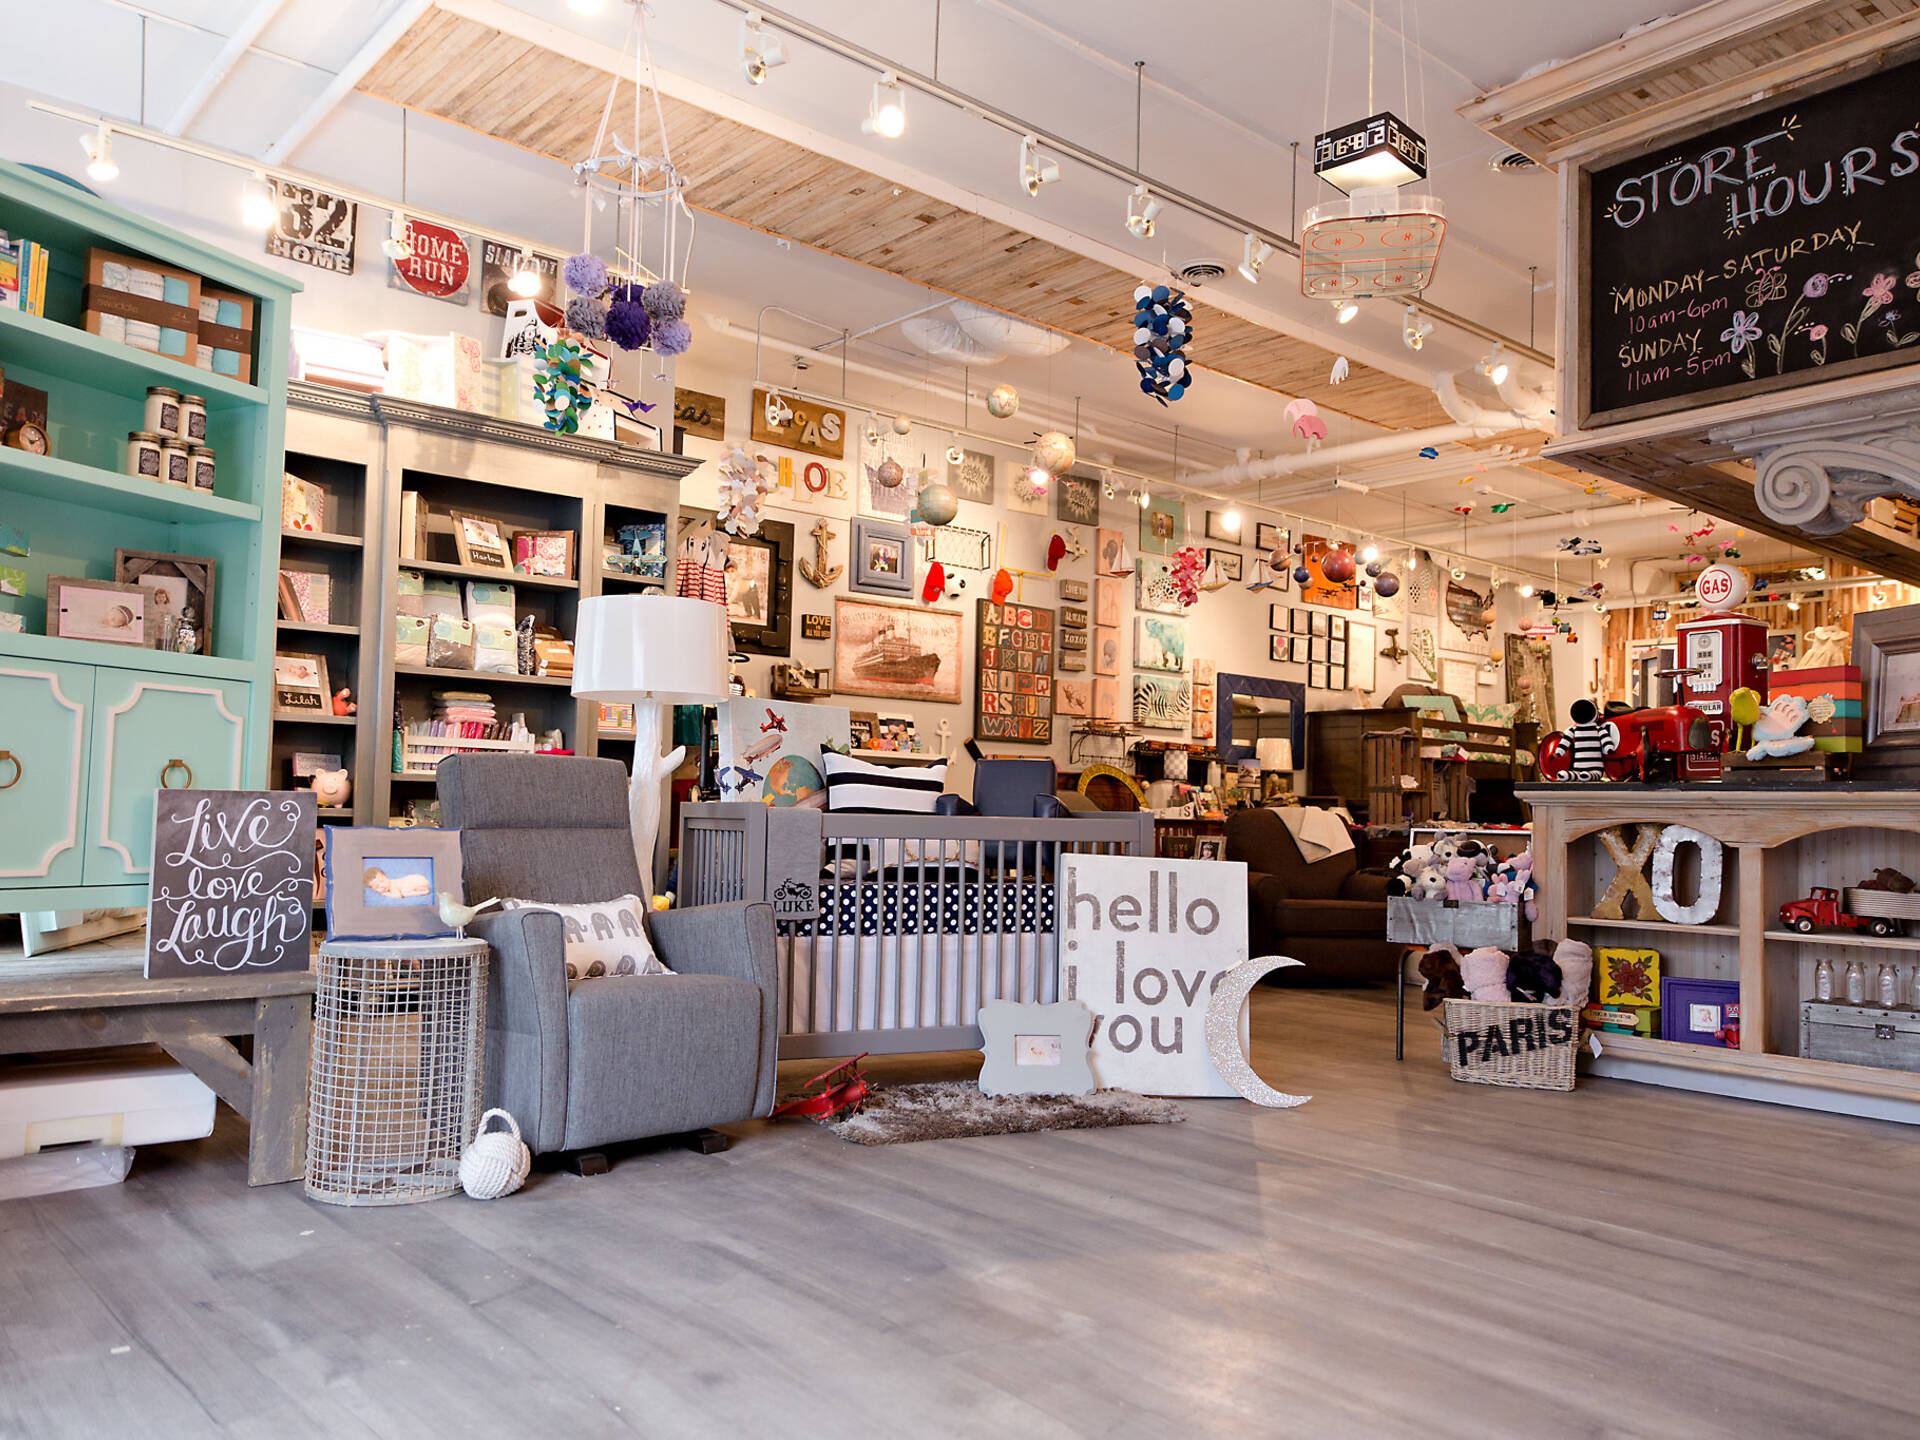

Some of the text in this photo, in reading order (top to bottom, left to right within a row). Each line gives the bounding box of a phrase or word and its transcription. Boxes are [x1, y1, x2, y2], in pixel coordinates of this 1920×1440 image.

[1612, 130, 1788, 228] STORE
[1726, 130, 1920, 229] HOURS
[272, 237, 352, 273] HOME
[403, 229, 463, 266] HOME
[408, 256, 456, 287] RUN
[1618, 329, 1702, 368] SUNDAY
[1702, 578, 1729, 595] GAS
[806, 614, 831, 626] LOVE
[167, 798, 294, 868] Live
[170, 866, 287, 902] love
[1067, 866, 1220, 935] hello
[773, 900, 815, 913] LUKE
[157, 896, 300, 971] Laugh
[1067, 940, 1078, 1000] i
[1457, 1008, 1573, 1067] PARIS
